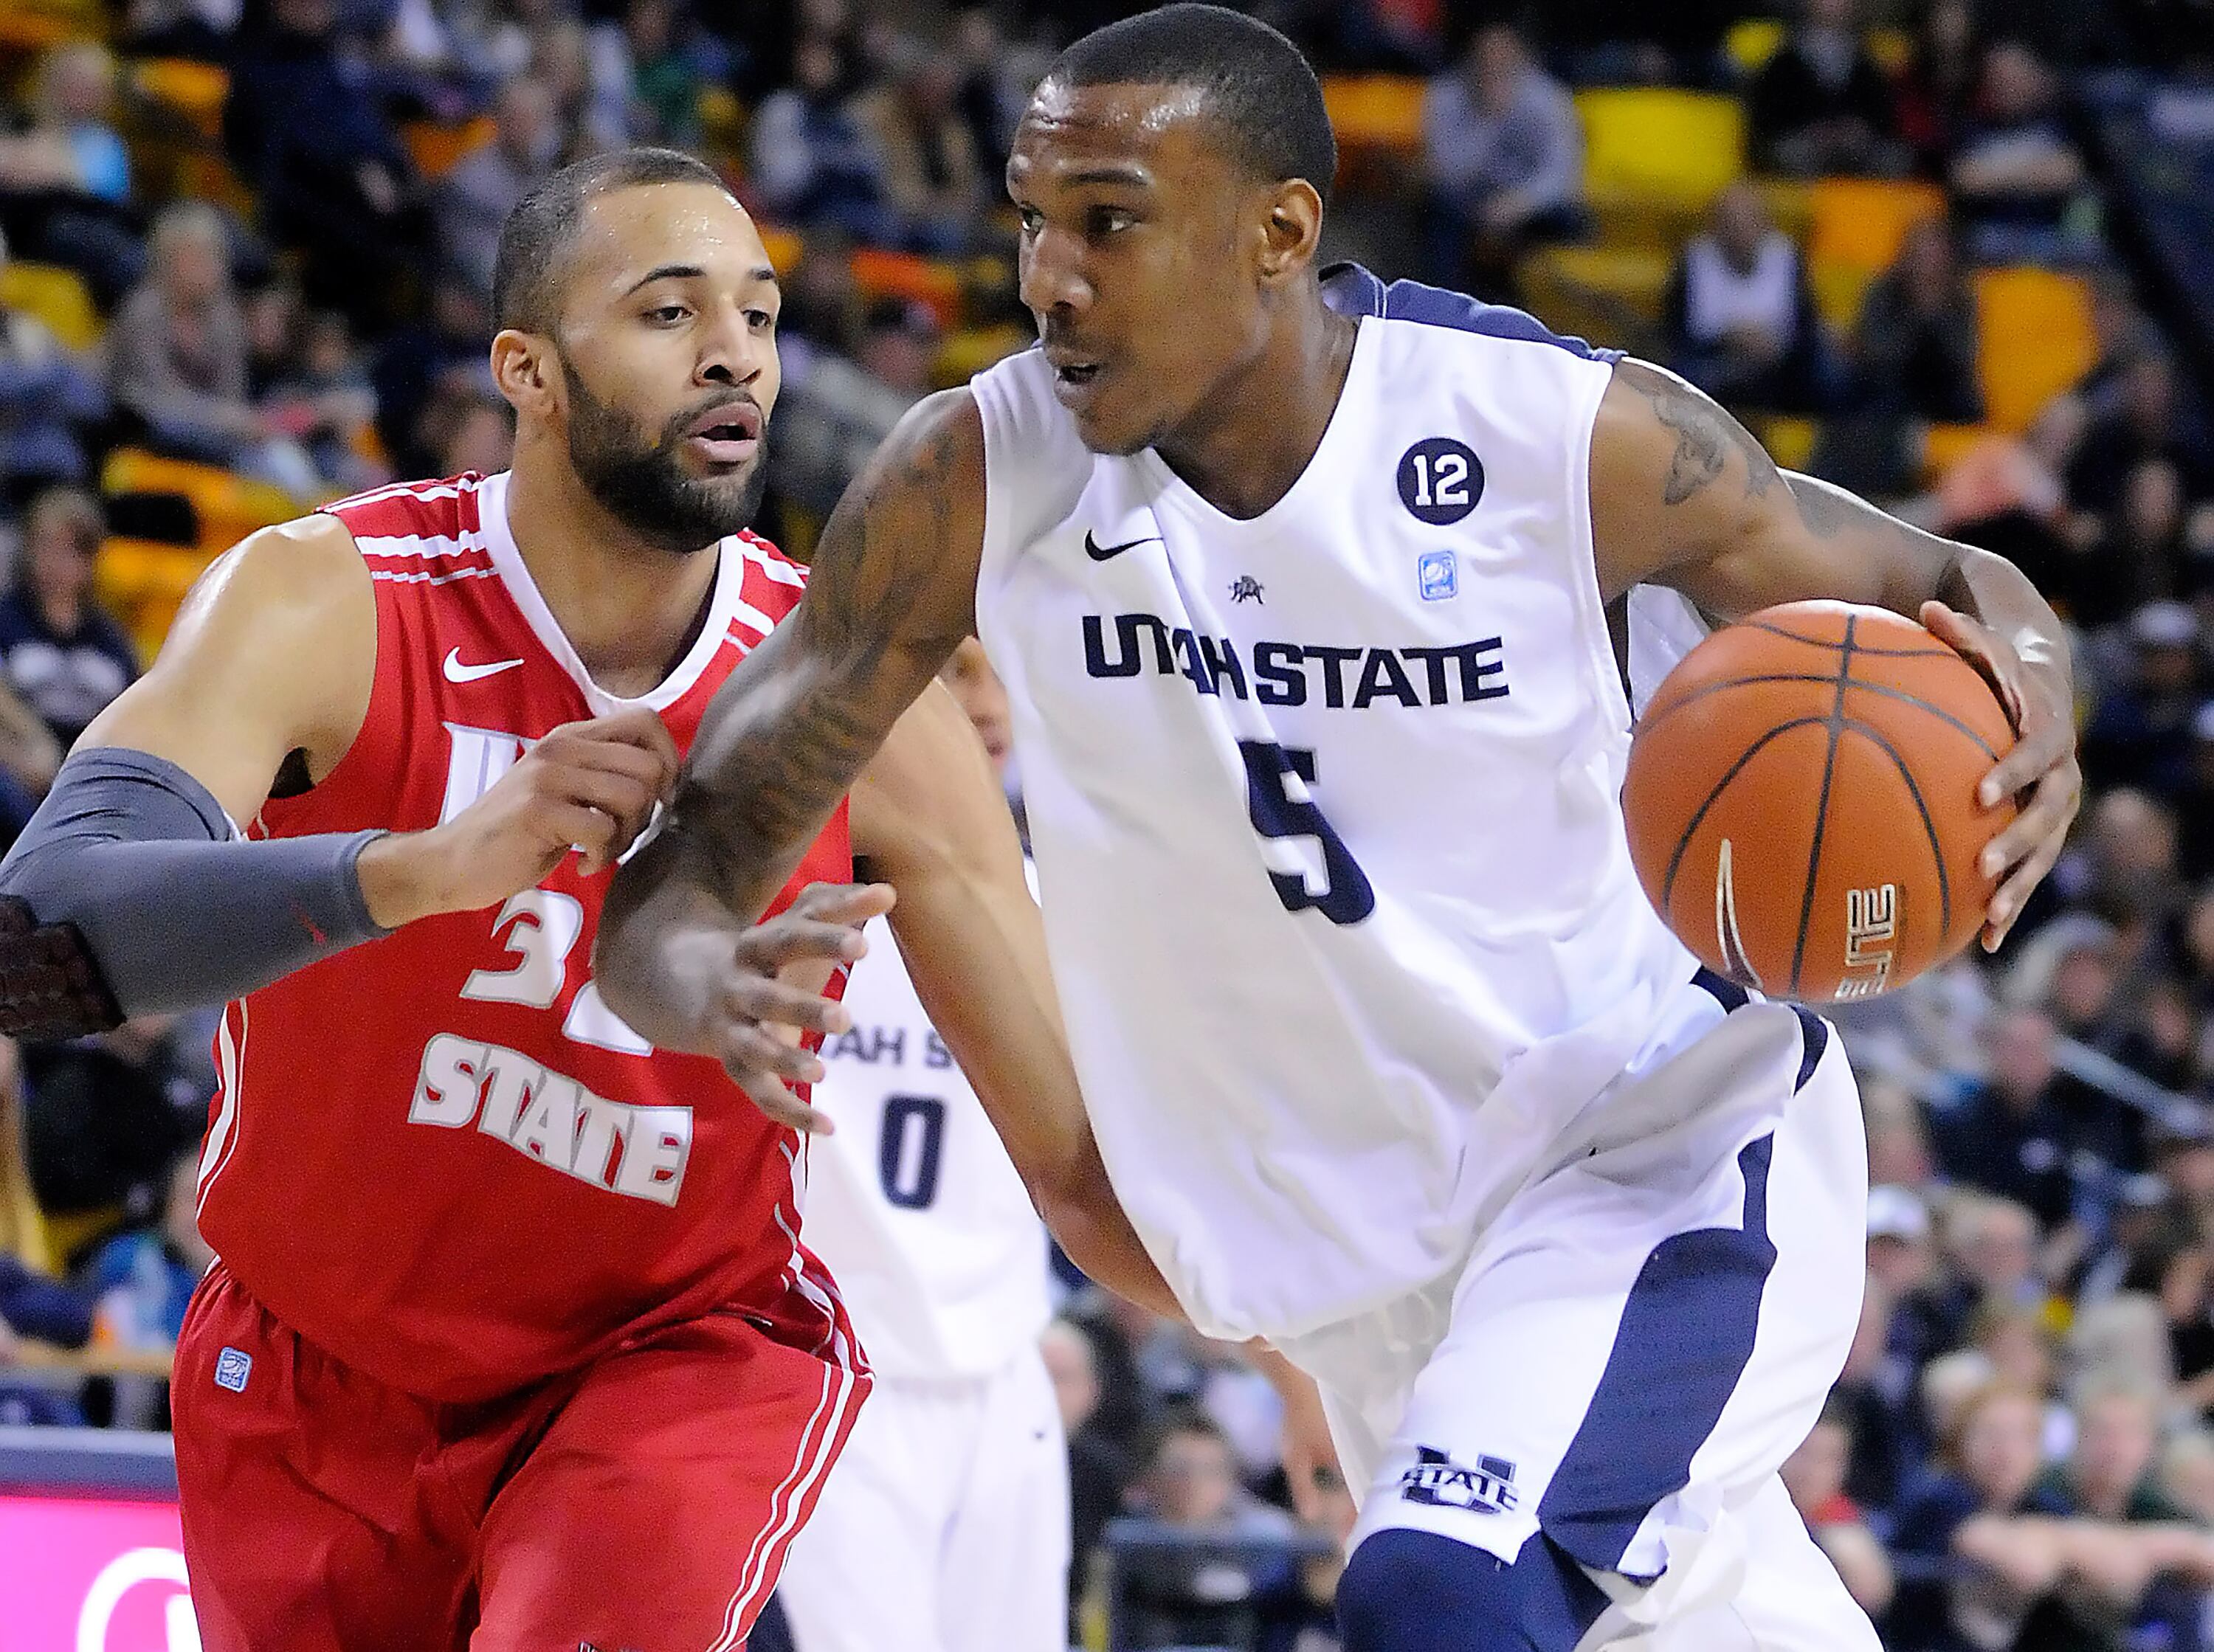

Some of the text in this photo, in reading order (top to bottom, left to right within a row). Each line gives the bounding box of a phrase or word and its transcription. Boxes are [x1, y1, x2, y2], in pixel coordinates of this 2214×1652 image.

[1413, 453, 1469, 506] 12
[1081, 613, 1510, 709] UTAH STATE
[1238, 739, 1376, 925] 5
[828, 1026, 952, 1067] AH S
[408, 1032, 693, 1208] STATE
[881, 1095, 946, 1208] 0
